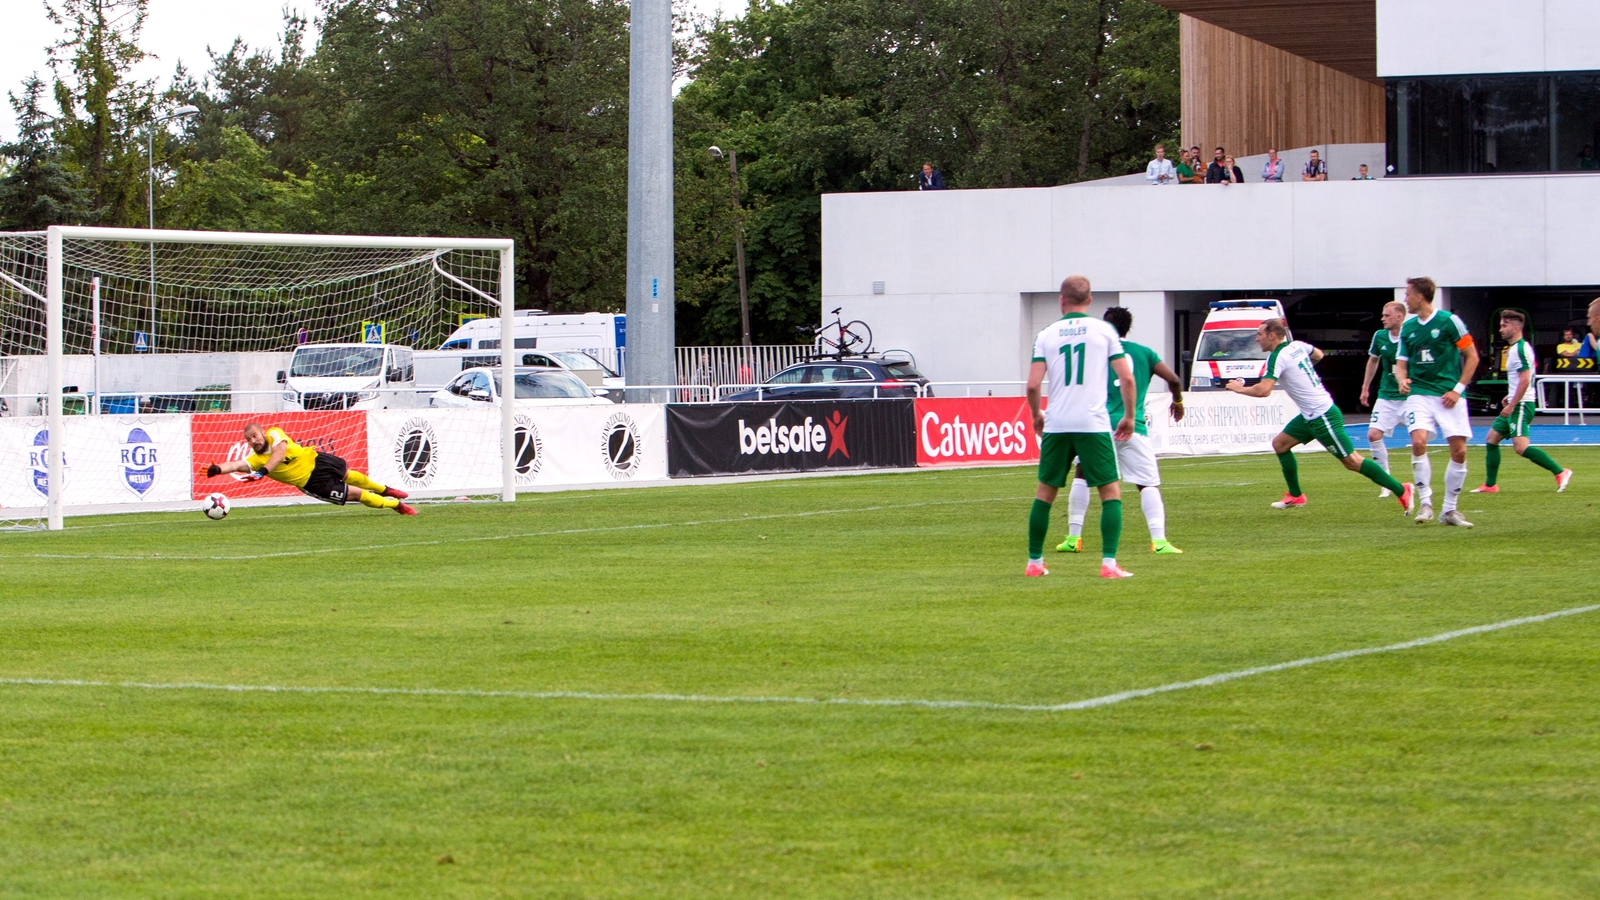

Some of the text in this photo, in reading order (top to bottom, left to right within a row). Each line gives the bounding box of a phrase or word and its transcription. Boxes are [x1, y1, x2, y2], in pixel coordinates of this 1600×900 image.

[1059, 326, 1087, 337] DOOLEY
[1059, 342, 1086, 387] 11
[1168, 404, 1285, 428] ERESS SHIPPING SERVICE
[738, 416, 827, 455] betsafe
[921, 411, 1027, 457] Catwees
[120, 445, 158, 466] RGR
